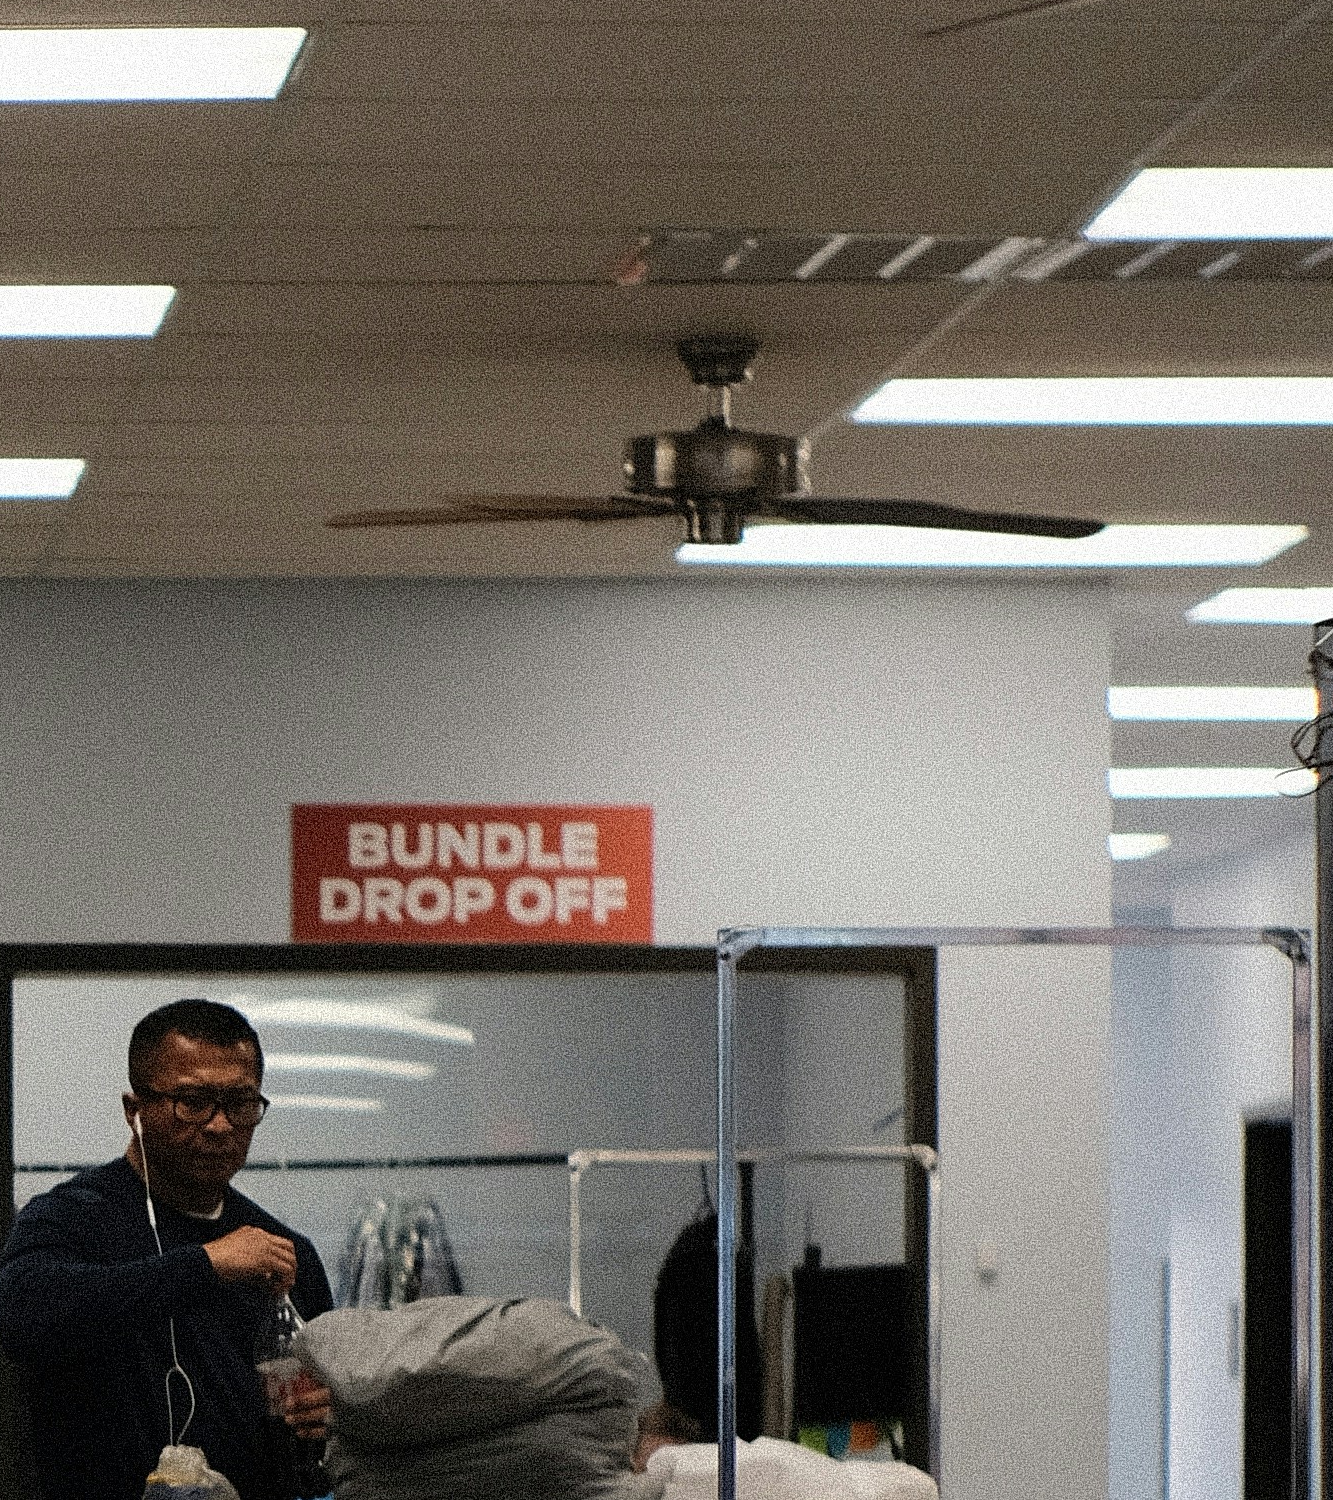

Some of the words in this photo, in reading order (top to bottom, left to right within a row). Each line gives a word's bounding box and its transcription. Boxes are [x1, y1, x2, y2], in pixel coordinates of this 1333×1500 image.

[347, 821, 600, 870] BUNDLE
[318, 876, 495, 924] DROP
[505, 876, 628, 925] OFF
